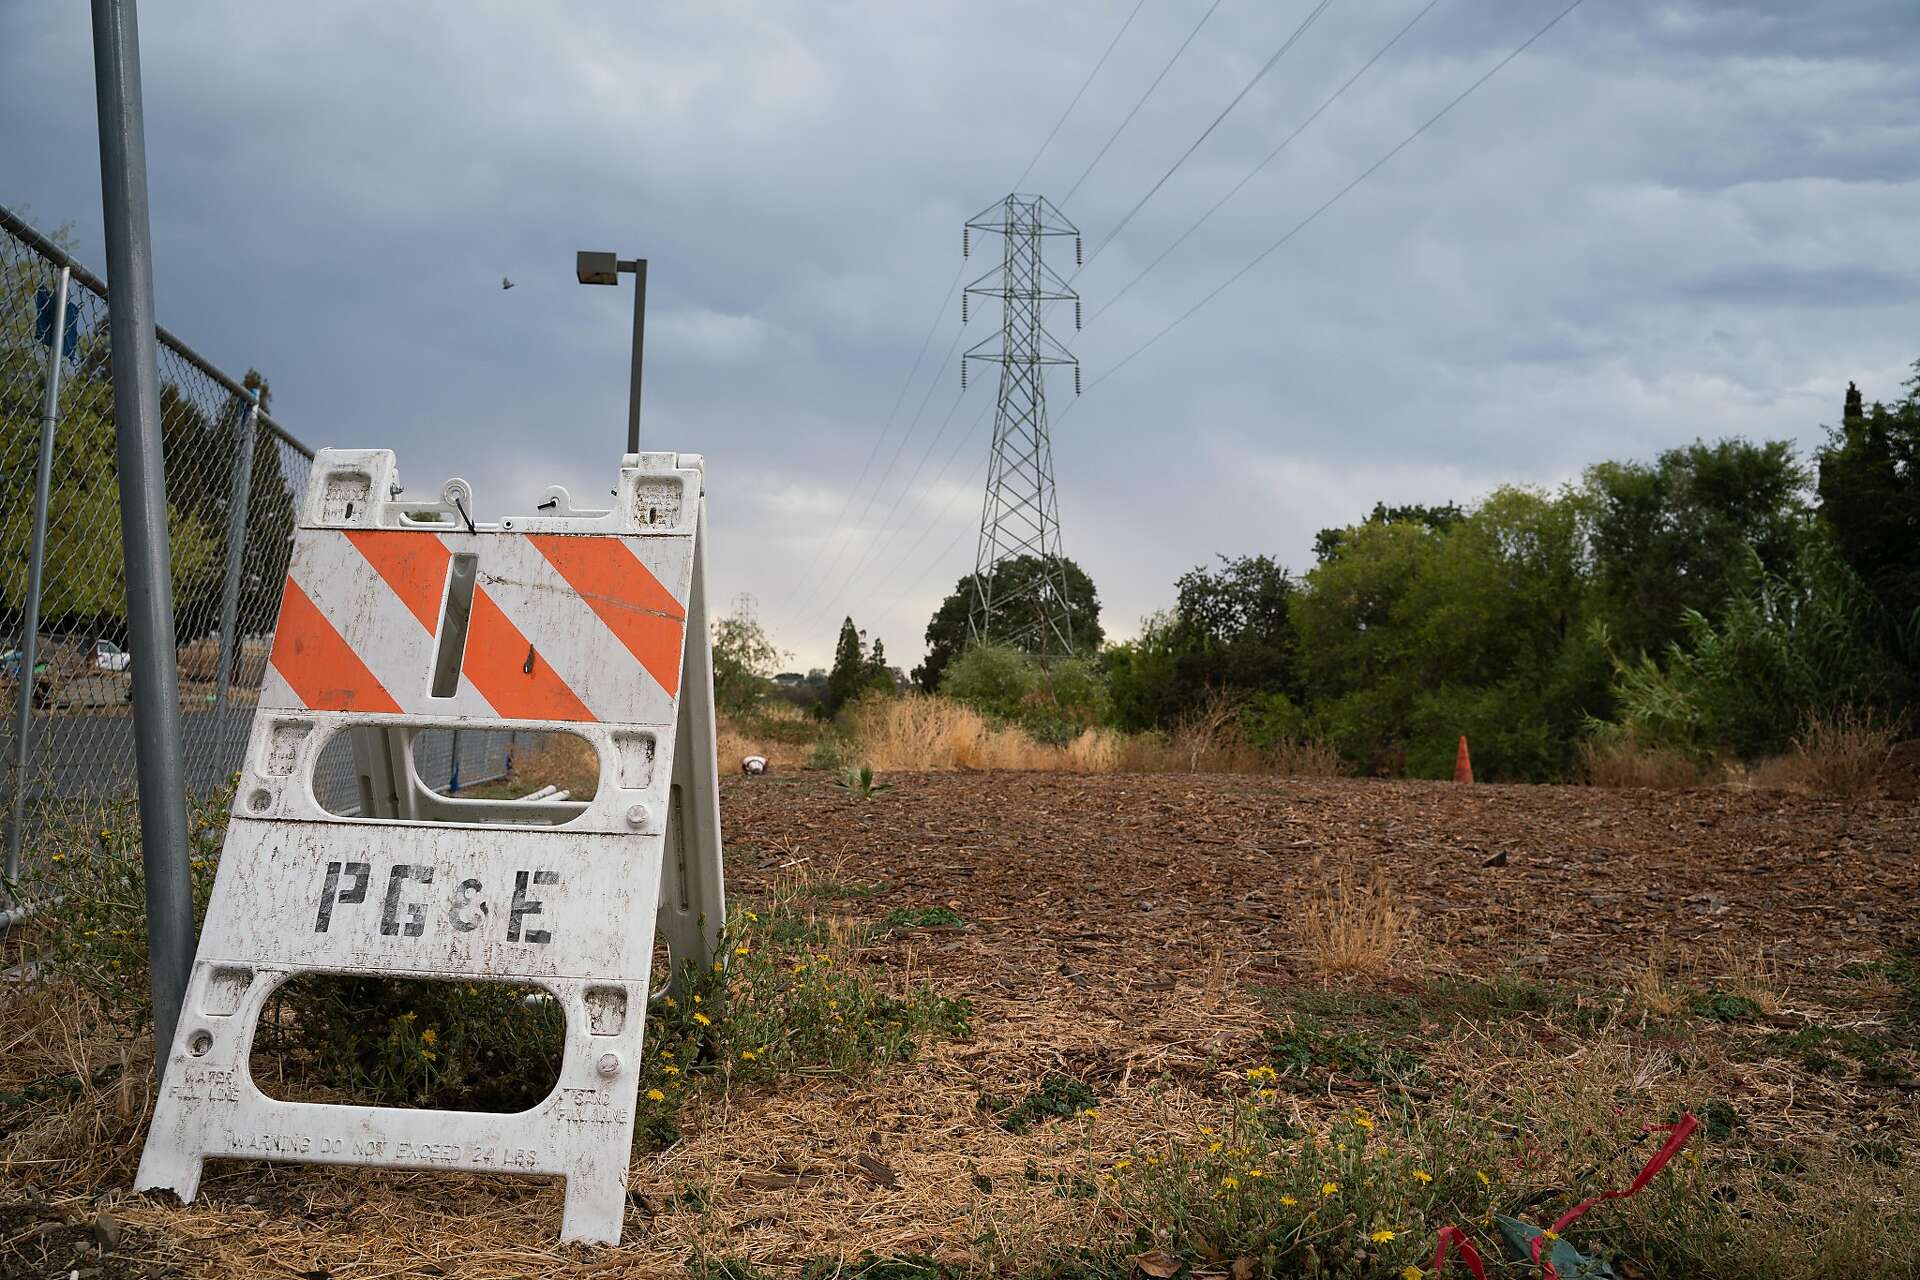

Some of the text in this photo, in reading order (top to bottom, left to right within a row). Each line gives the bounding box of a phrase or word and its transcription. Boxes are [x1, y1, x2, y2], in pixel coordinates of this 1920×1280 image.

[314, 861, 560, 944] PG&E
[574, 1092, 611, 1106] SAND
[231, 1134, 312, 1154] WARNING
[319, 1136, 344, 1154] DO
[352, 1139, 388, 1158] NOT
[396, 1142, 462, 1162] EXCEED
